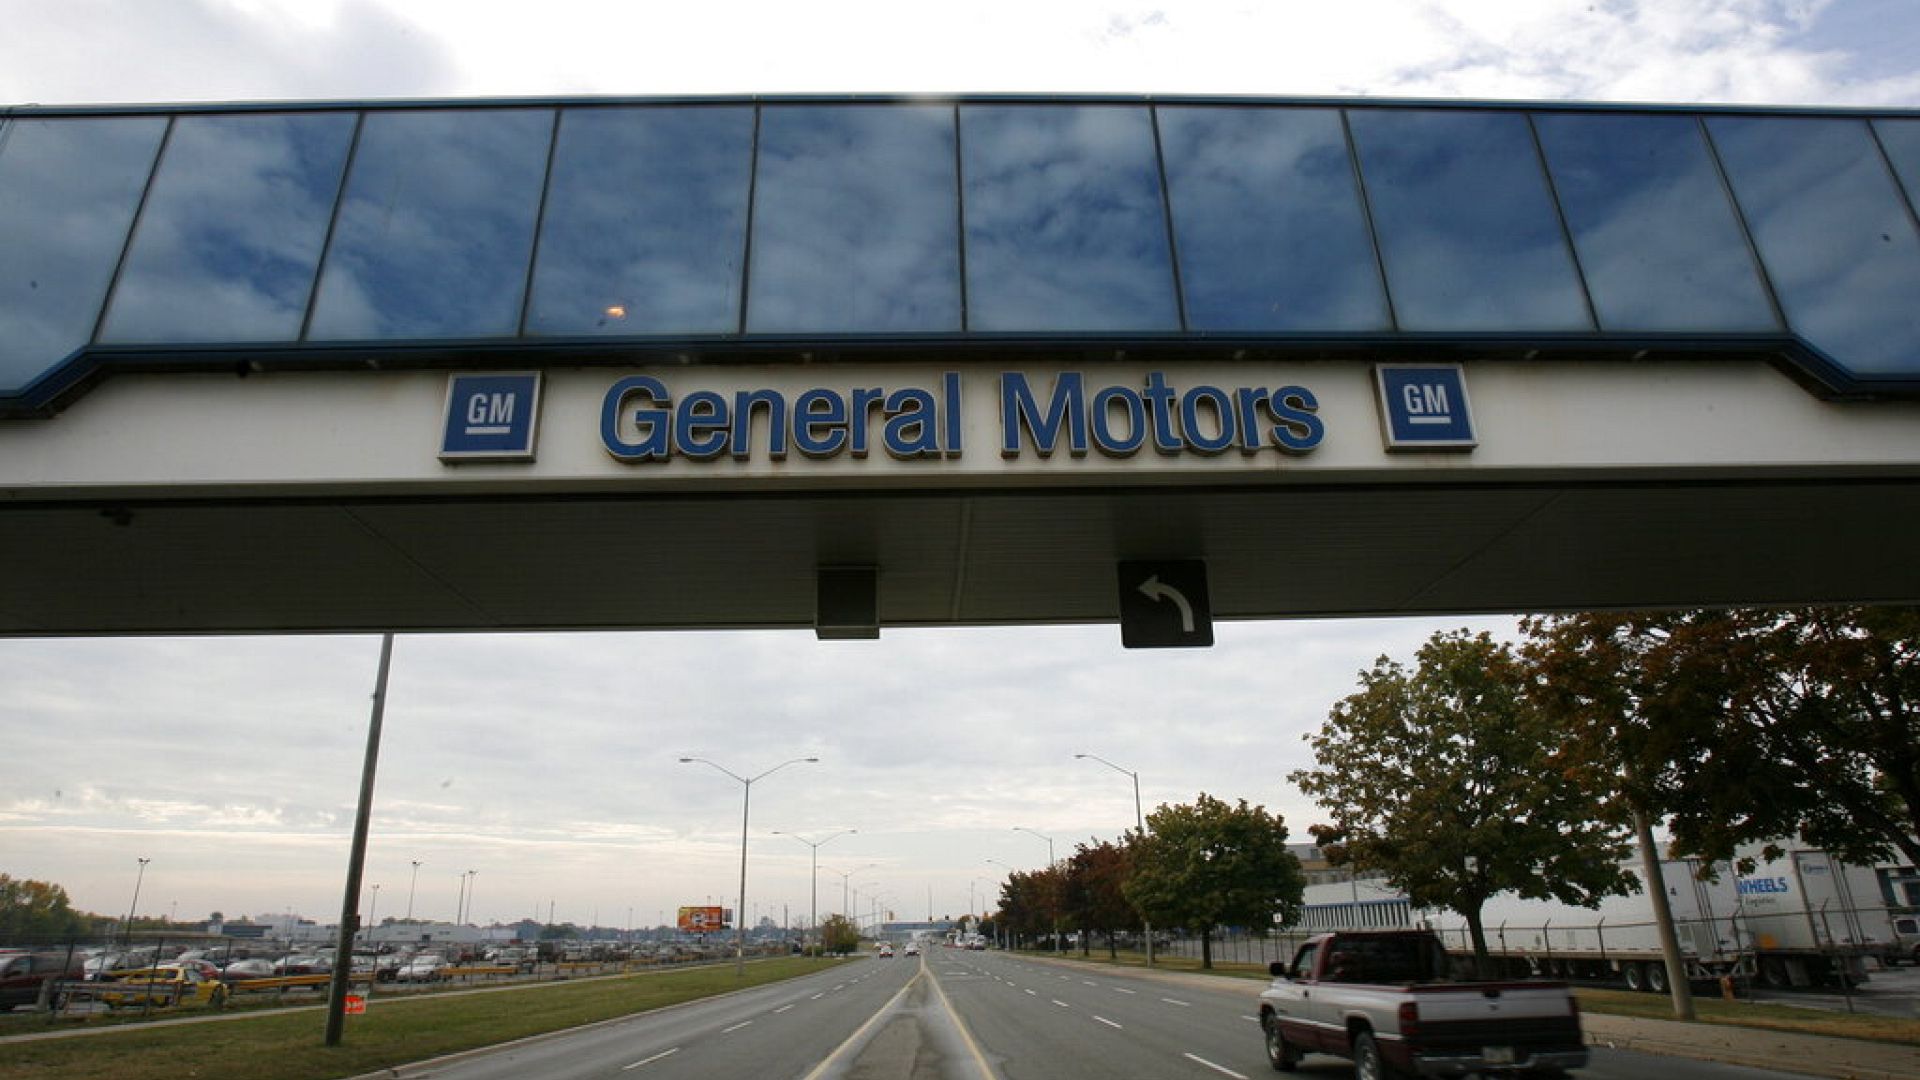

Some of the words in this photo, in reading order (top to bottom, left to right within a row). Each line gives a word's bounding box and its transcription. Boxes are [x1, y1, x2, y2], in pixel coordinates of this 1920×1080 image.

[467, 392, 516, 424] GM
[1403, 383, 1450, 413] GM
[601, 371, 963, 461] General
[1000, 370, 1326, 458] Motors
[1736, 877, 1788, 894] WHEELS
